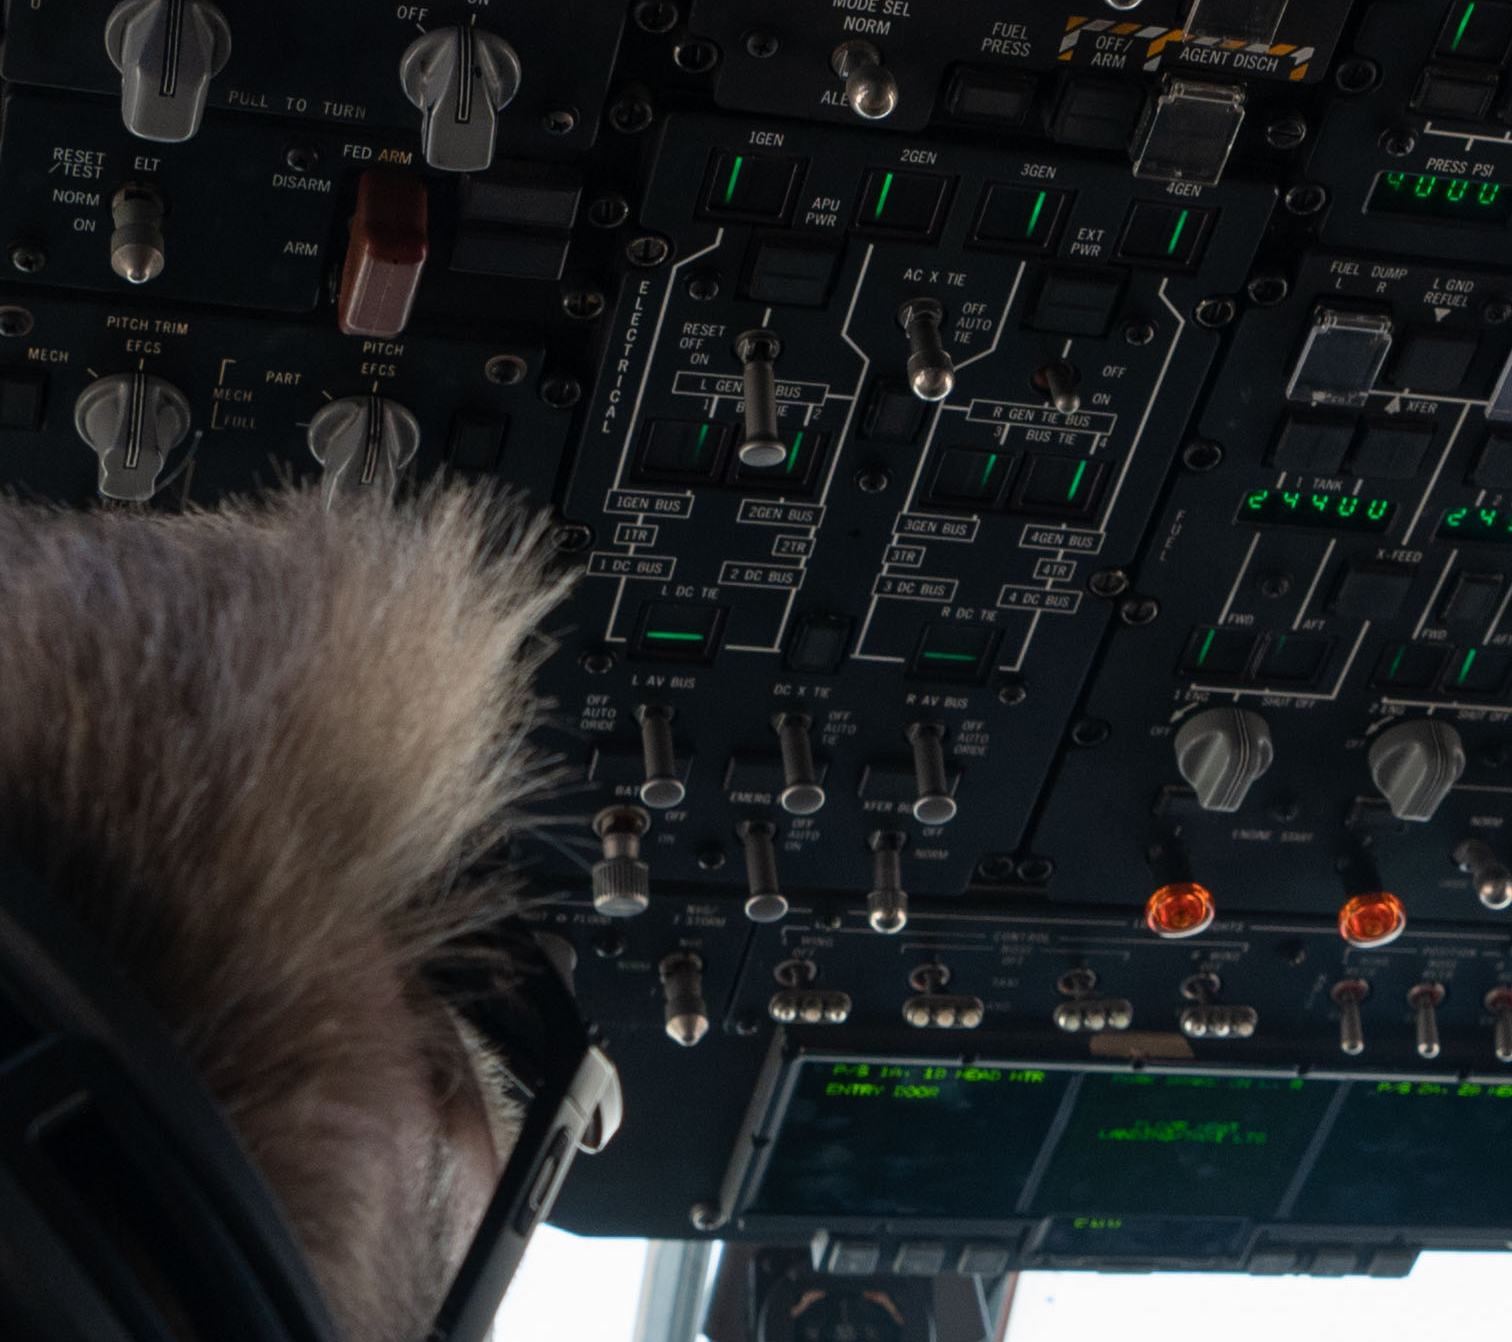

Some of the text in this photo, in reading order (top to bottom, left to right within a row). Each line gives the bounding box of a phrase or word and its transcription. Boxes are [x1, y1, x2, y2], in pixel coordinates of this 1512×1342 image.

[844, 15, 892, 38] NORM
[1180, 45, 1279, 74] AGENT DISCH
[227, 89, 367, 120] PULL TO TURN
[52, 146, 106, 167] RESET
[133, 155, 161, 173] ELT
[342, 143, 413, 166] FED ARM
[271, 173, 332, 195] DISARM
[52, 187, 101, 208] NORM
[903, 268, 966, 288] AC X TIE
[106, 315, 189, 337] PITCH TRIM
[27, 345, 69, 365] MECH
[125, 338, 162, 356] EFCS
